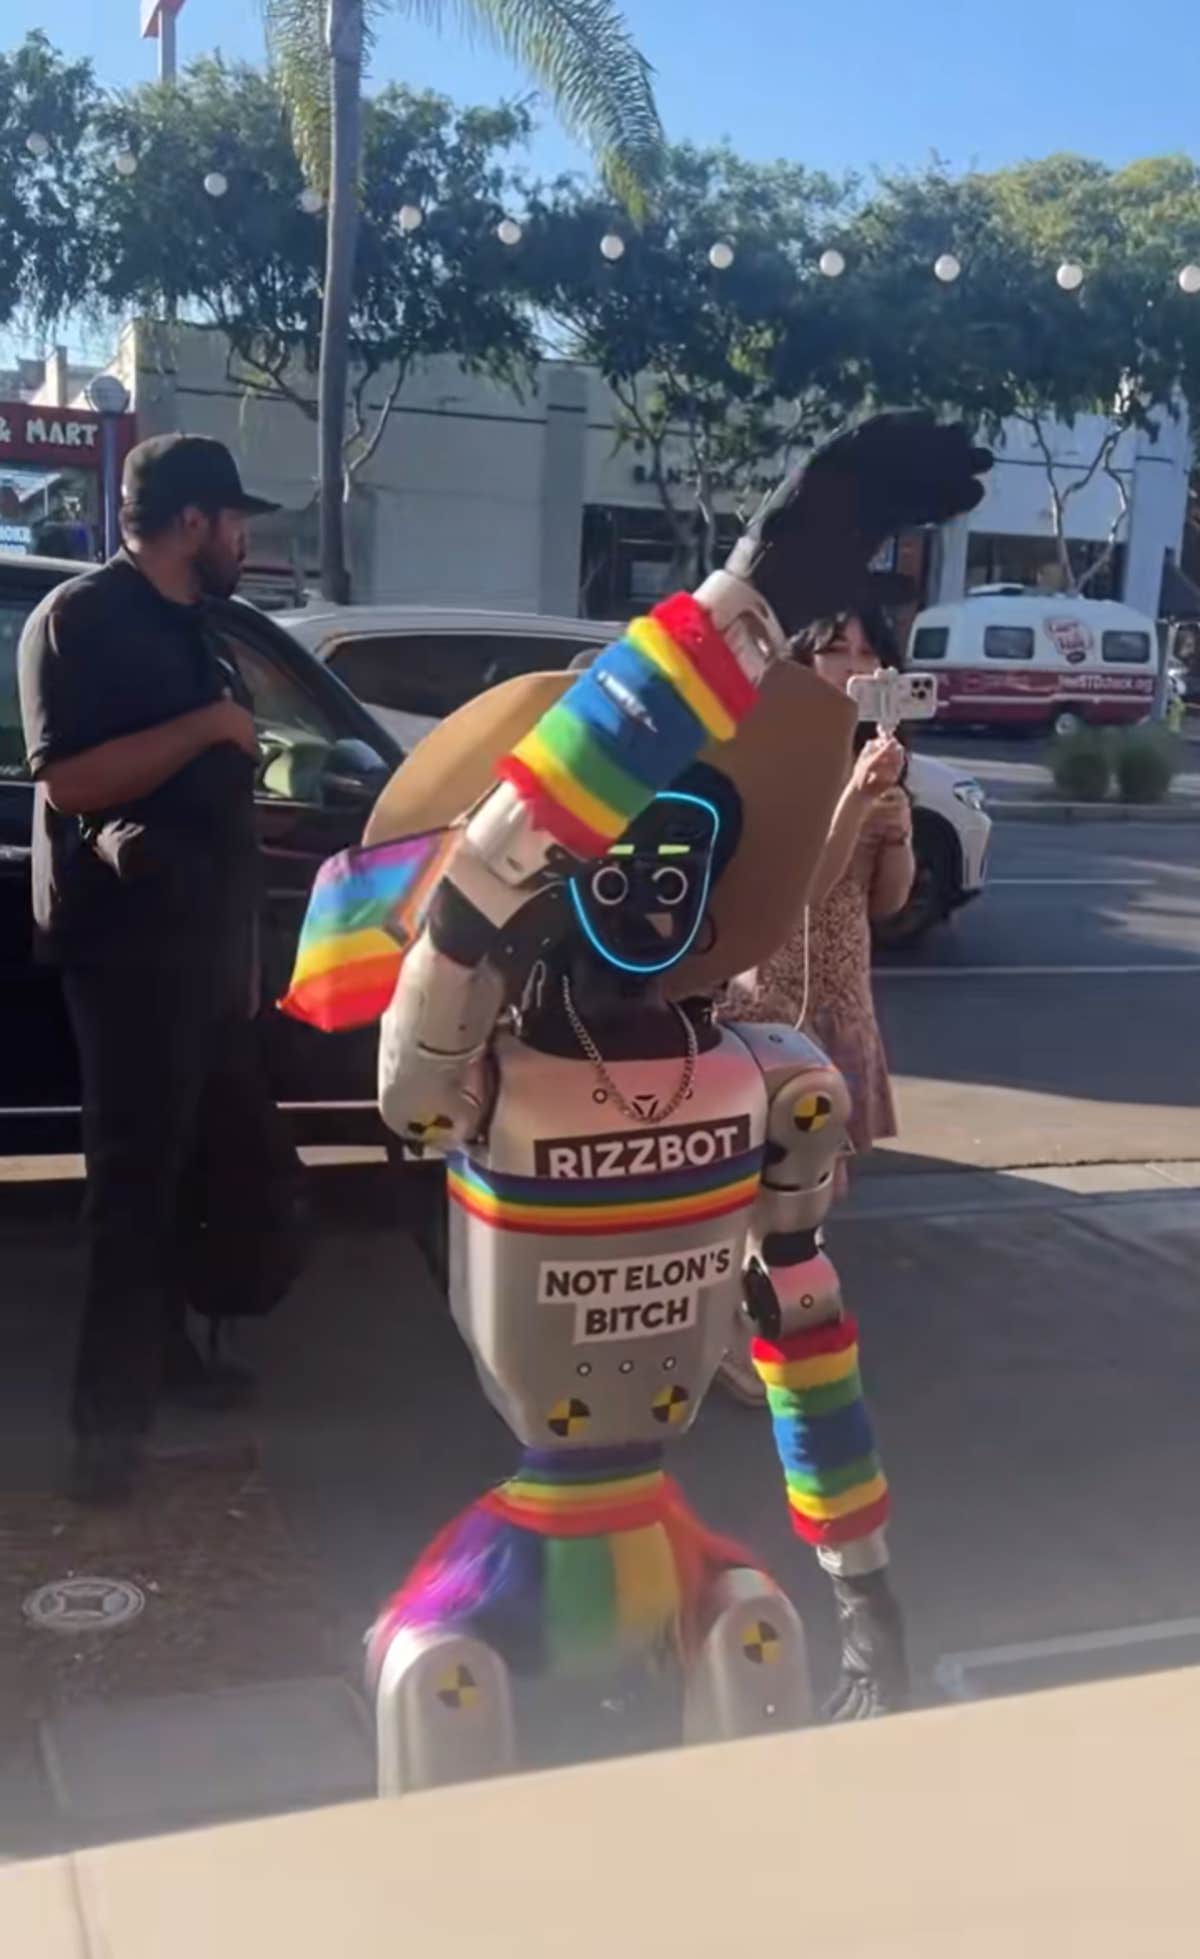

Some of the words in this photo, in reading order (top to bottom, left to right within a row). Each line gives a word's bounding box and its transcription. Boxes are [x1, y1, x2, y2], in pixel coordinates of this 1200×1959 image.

[27, 418, 98, 446] MART
[549, 1126, 738, 1178] RIZZBOT
[546, 1268, 618, 1296] NOT
[624, 1248, 730, 1291] ELON'S
[584, 1297, 690, 1336] BITCH
